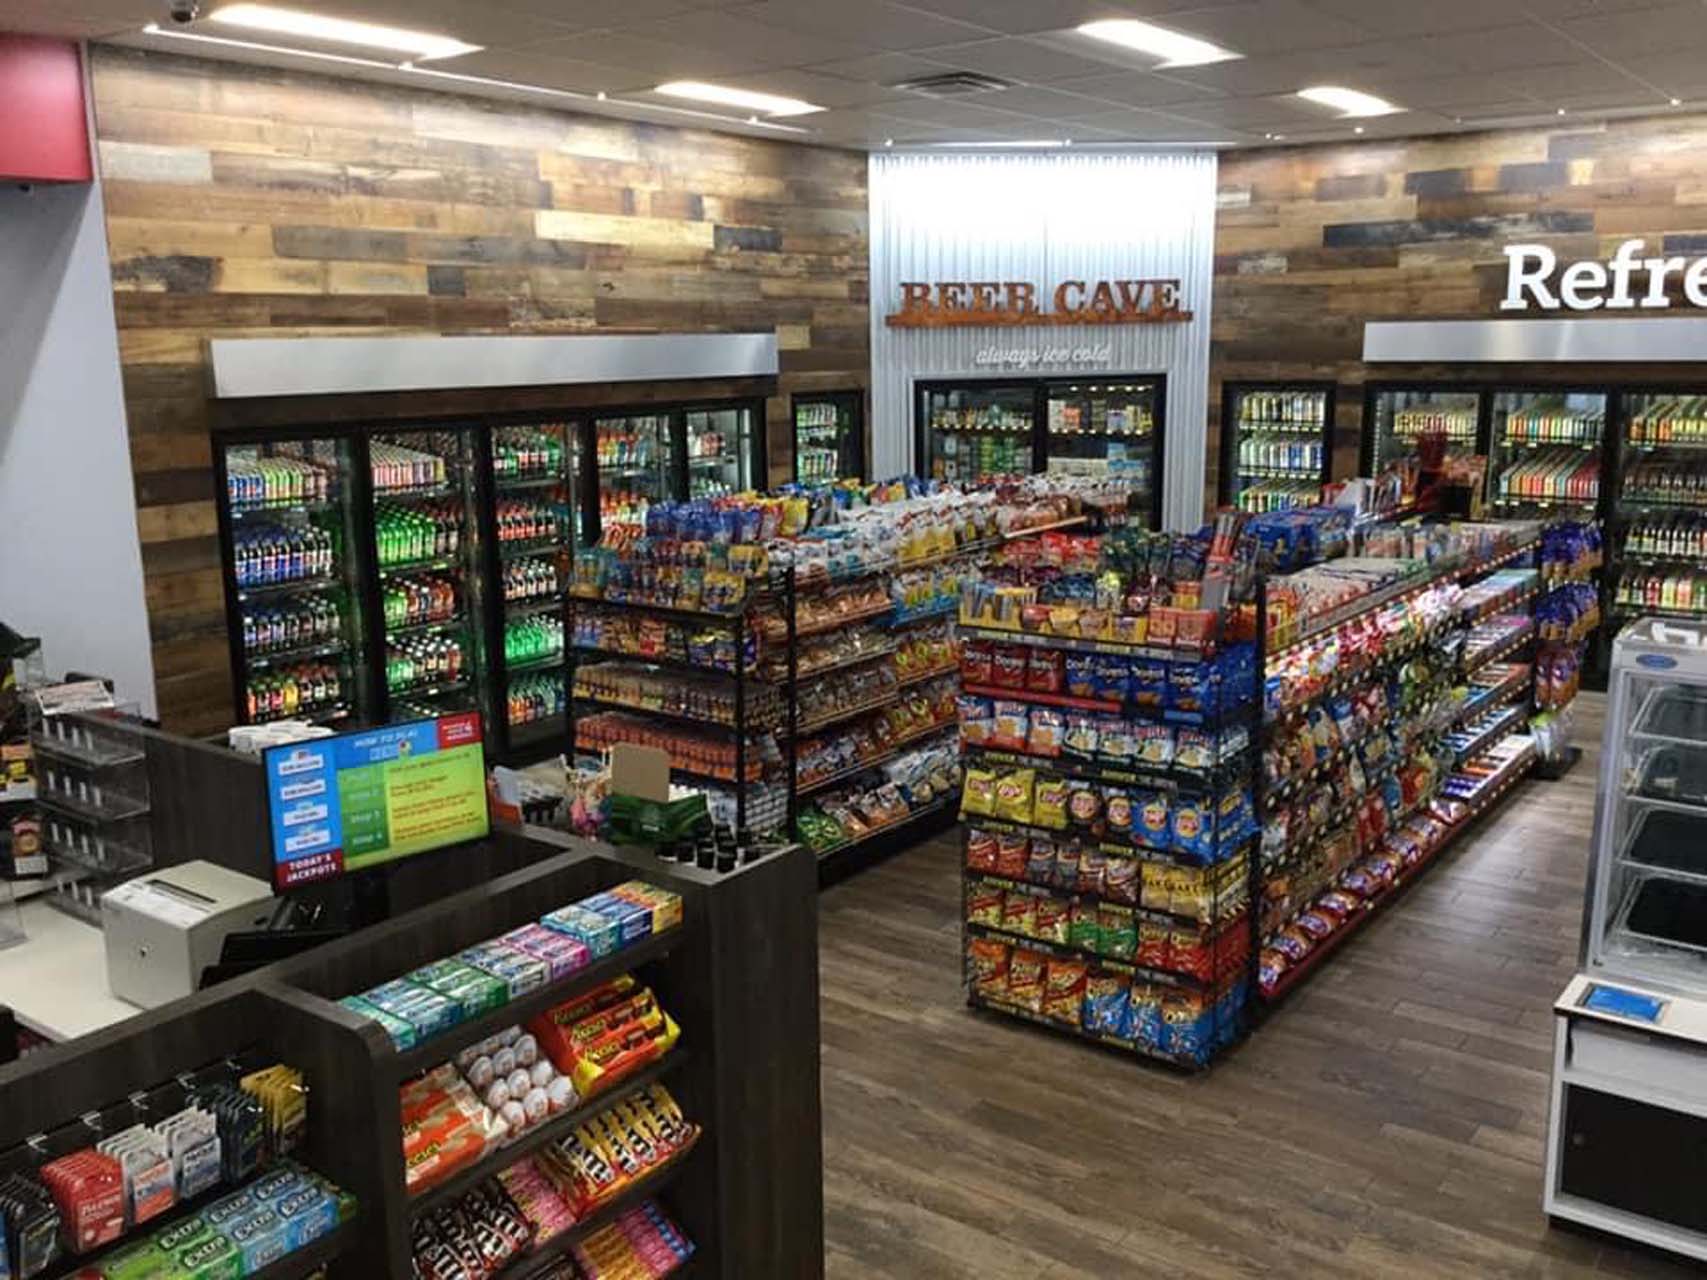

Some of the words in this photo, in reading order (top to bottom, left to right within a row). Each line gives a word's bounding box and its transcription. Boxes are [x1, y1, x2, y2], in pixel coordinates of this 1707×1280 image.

[900, 281, 1040, 316] BEER
[1053, 279, 1182, 314] CAVE
[976, 345, 1040, 369] always
[1041, 345, 1070, 363] ice
[1071, 342, 1111, 363] cold
[287, 862, 337, 882] JACKPOTS
[289, 852, 332, 871] TODAY'S
